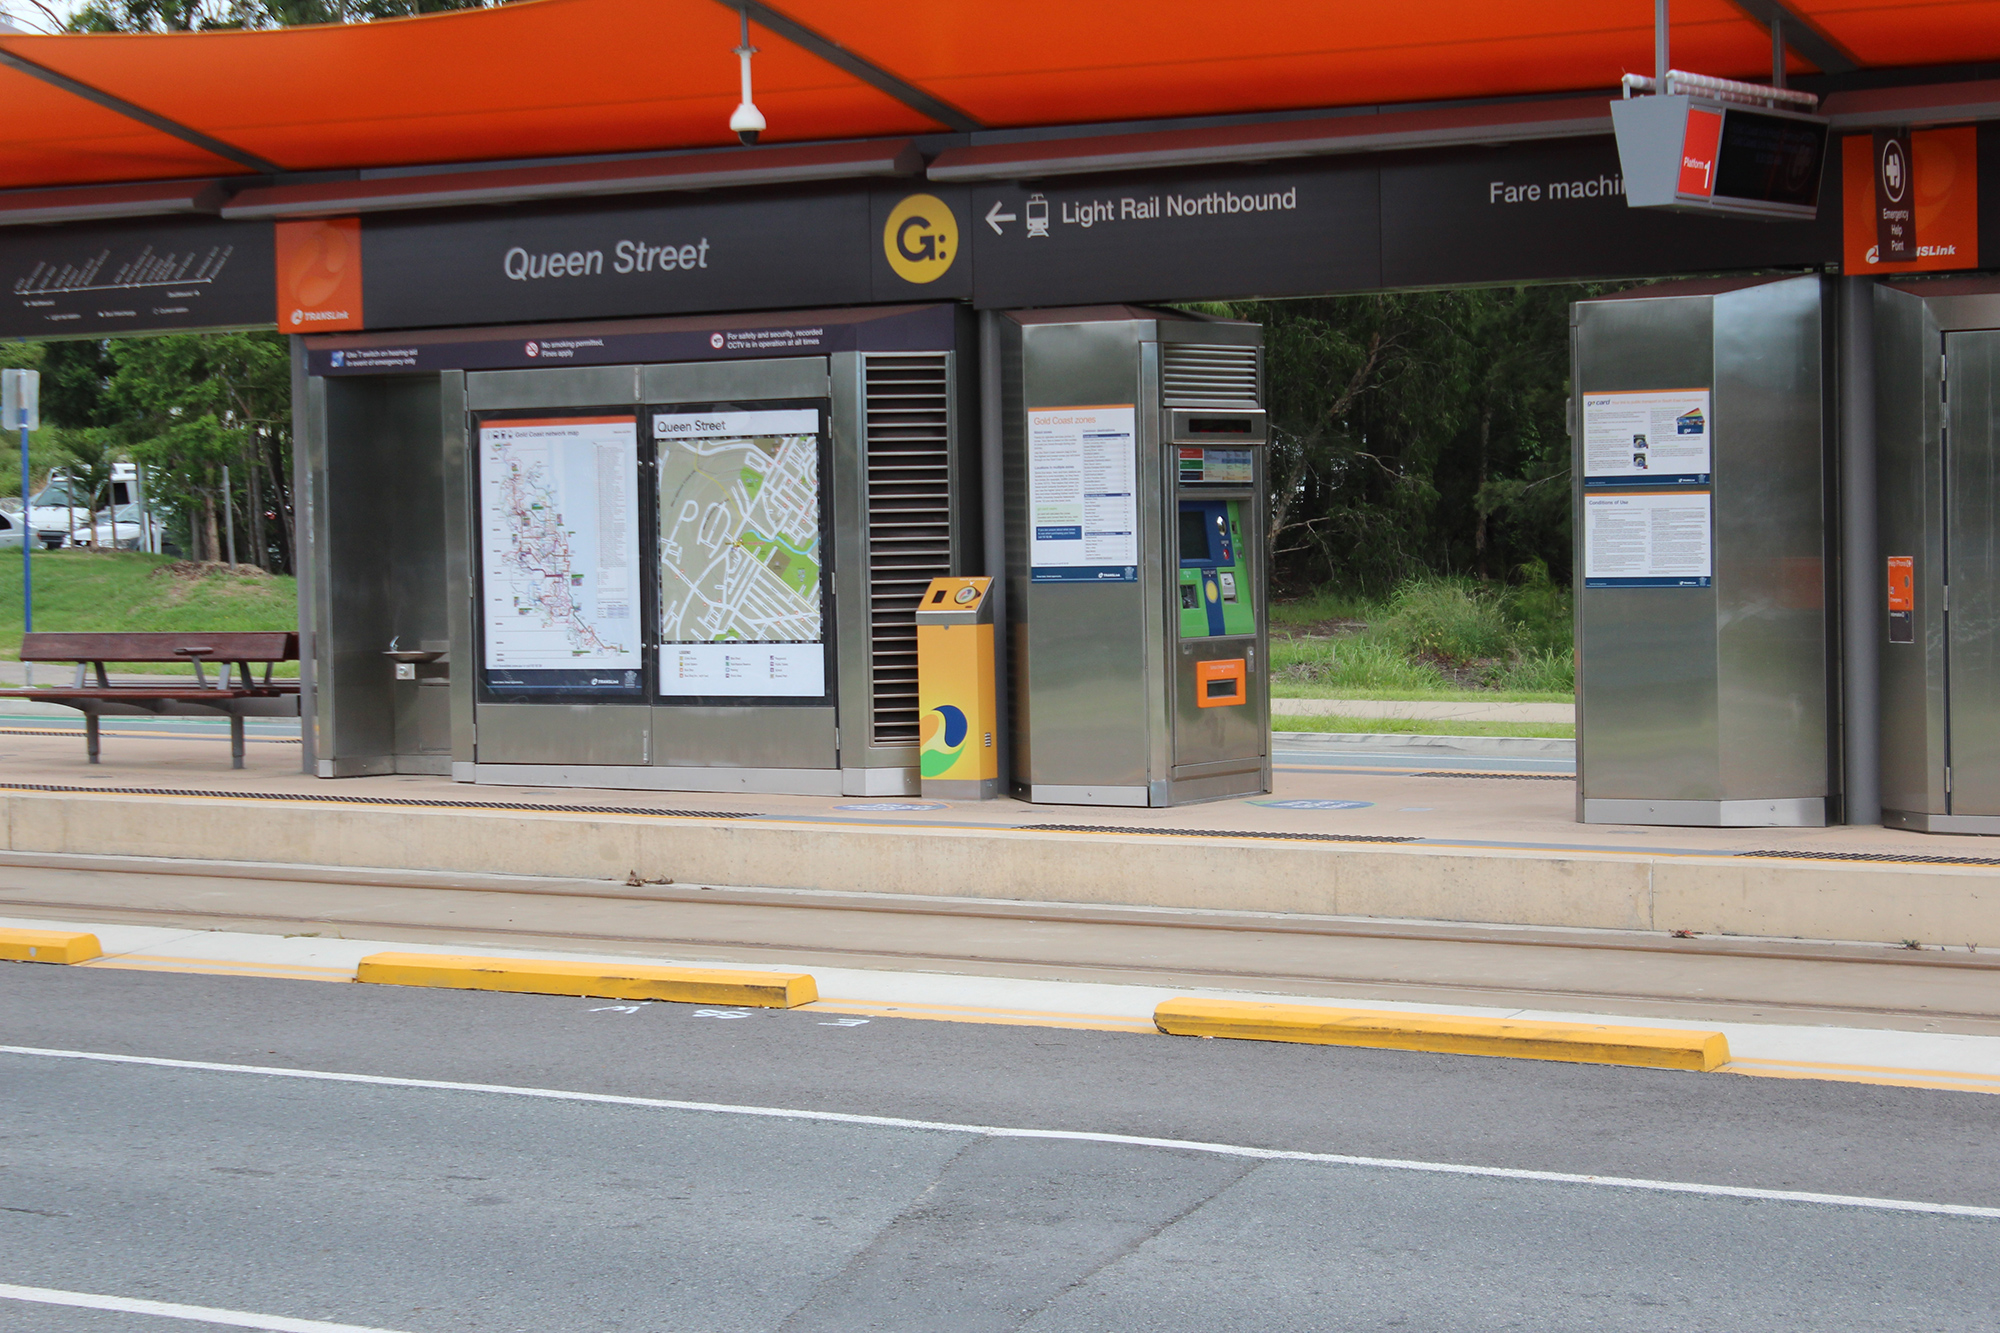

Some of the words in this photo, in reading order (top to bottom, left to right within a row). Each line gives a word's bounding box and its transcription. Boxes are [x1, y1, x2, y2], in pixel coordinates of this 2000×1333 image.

[1684, 156, 1704, 169] Platform
[1704, 160, 1712, 188] 1
[1490, 182, 1541, 204] Fare
[1062, 201, 1114, 228] Light
[1121, 196, 1160, 220] Rail
[1167, 187, 1296, 218] Northbound
[1883, 208, 1909, 222] Emergency
[1891, 224, 1903, 238] Help
[1891, 240, 1904, 252] Point
[504, 246, 604, 281] Queen
[613, 237, 710, 274] Street
[304, 310, 350, 320] TRANSLink
[727, 332, 738, 340] For
[738, 331, 757, 340] safety
[757, 330, 769, 339] and
[796, 328, 823, 336] recorded
[551, 340, 575, 349] smoking
[727, 340, 744, 349] CCTV
[745, 340, 751, 348] is
[752, 340, 758, 348] in
[758, 339, 787, 349] operation
[558, 349, 574, 358] apply
[657, 421, 692, 432] Queen
[694, 420, 726, 431] Street
[1034, 417, 1051, 425] Gold
[1052, 416, 1074, 425] Coast
